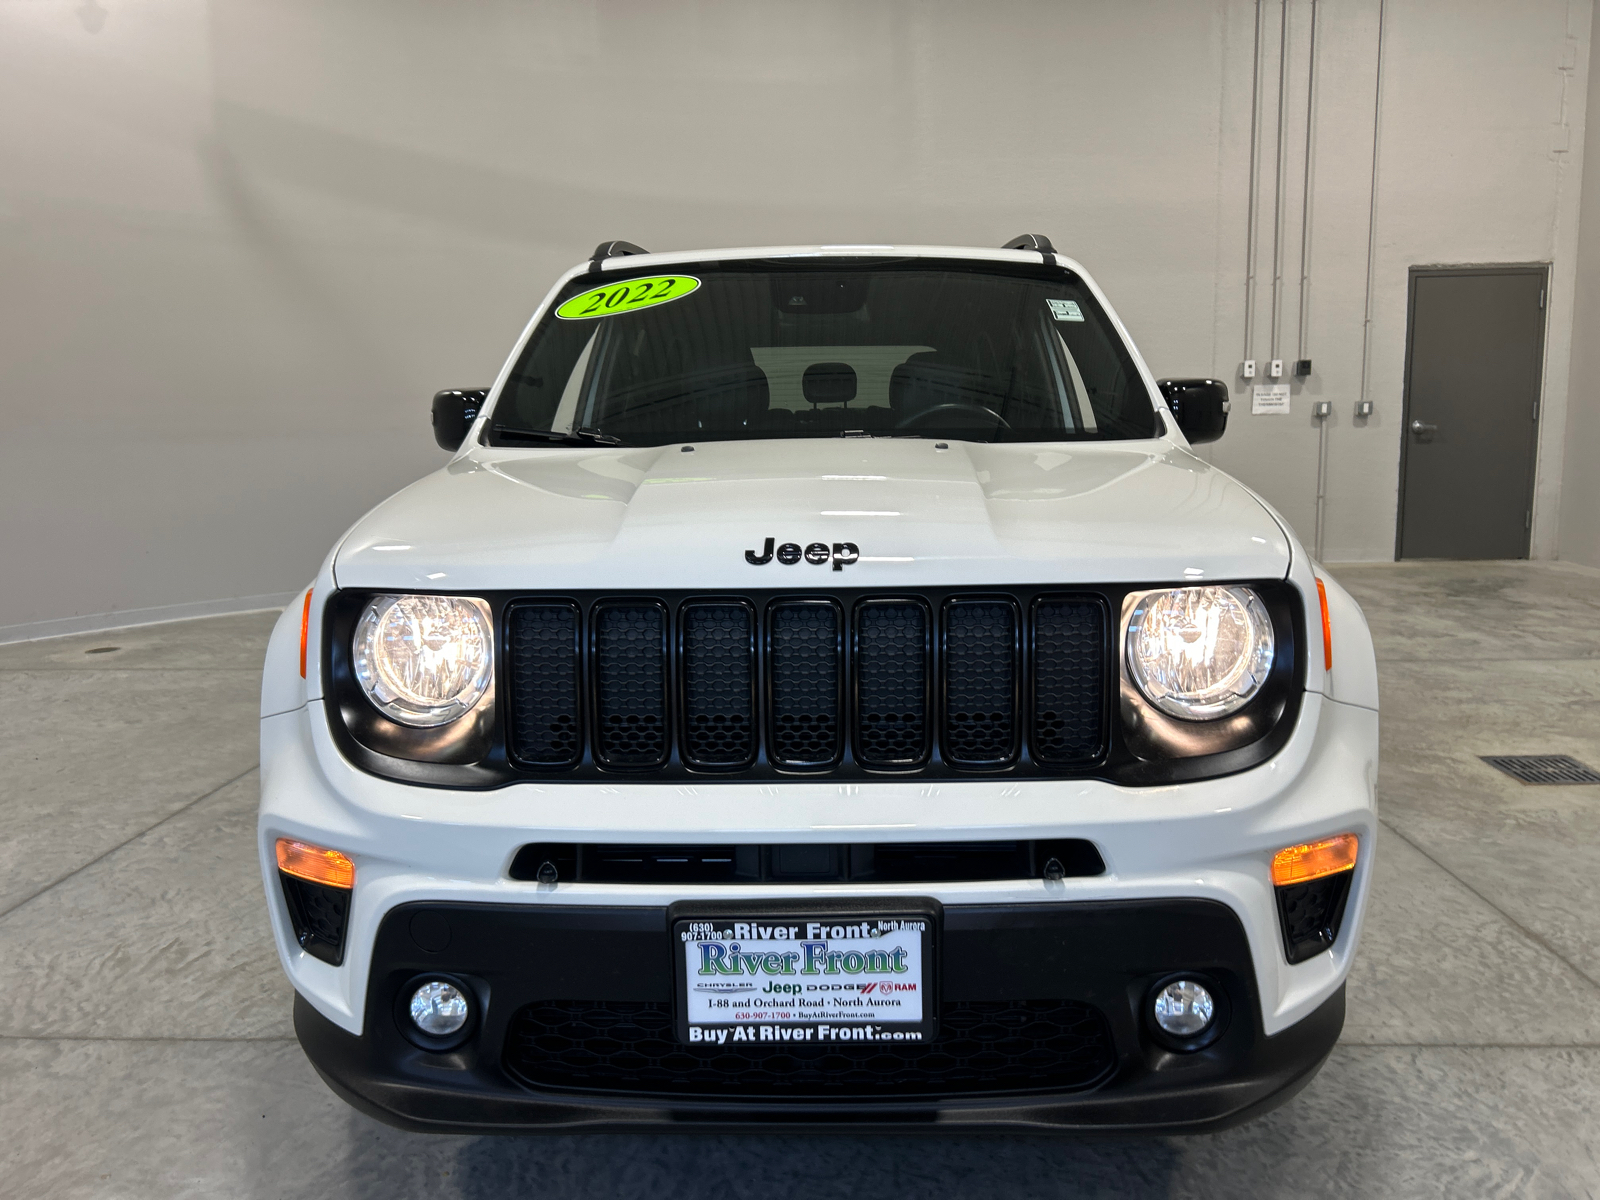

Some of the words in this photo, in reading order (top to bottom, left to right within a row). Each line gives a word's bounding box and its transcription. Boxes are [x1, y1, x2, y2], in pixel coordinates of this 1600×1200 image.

[579, 279, 676, 315] 2022
[745, 537, 860, 572] Jeep
[689, 923, 713, 932] (630)
[735, 923, 798, 940] River
[807, 922, 871, 939] Front
[878, 920, 899, 931] North
[900, 921, 925, 931] Aurora
[681, 932, 722, 941] 907-1700
[697, 941, 799, 976] River
[800, 940, 908, 975] Front
[763, 981, 802, 995] Jeep
[895, 983, 916, 991] RAM
[708, 999, 729, 1008] I-88
[732, 999, 750, 1007] and
[754, 998, 795, 1007] Orchard
[799, 998, 824, 1007] Road
[833, 997, 863, 1006] North
[866, 997, 901, 1006] Aurora
[735, 1011, 790, 1020] 630-907-1700
[798, 1011, 875, 1019] BuyAtRiverFront.com
[689, 1027, 728, 1044] Buy
[733, 1026, 755, 1041] At
[760, 1026, 813, 1040] River
